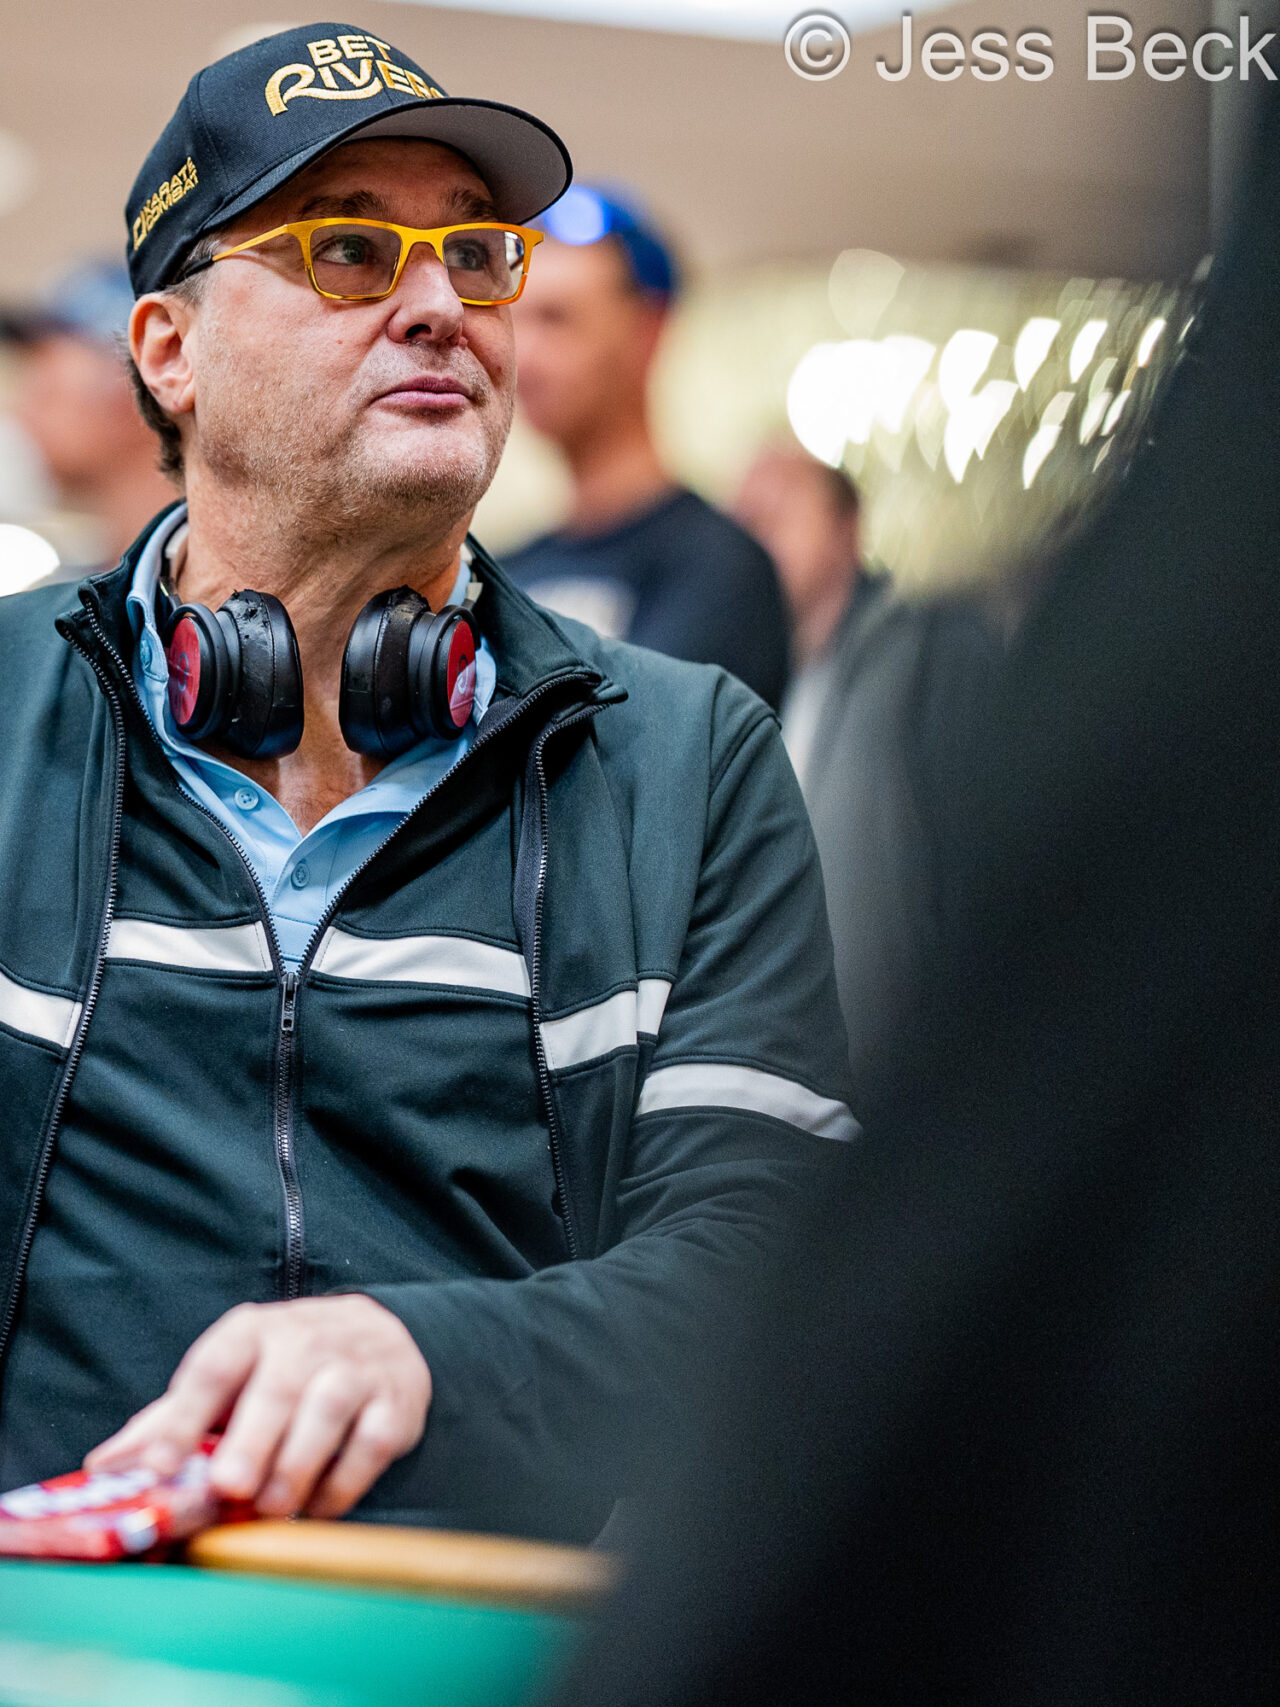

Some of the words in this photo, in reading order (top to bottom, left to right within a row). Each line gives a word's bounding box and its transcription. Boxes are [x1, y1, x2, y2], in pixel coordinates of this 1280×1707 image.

[306, 34, 392, 66] BET
[143, 156, 197, 216] KARATE
[146, 168, 199, 232] COMBAT
